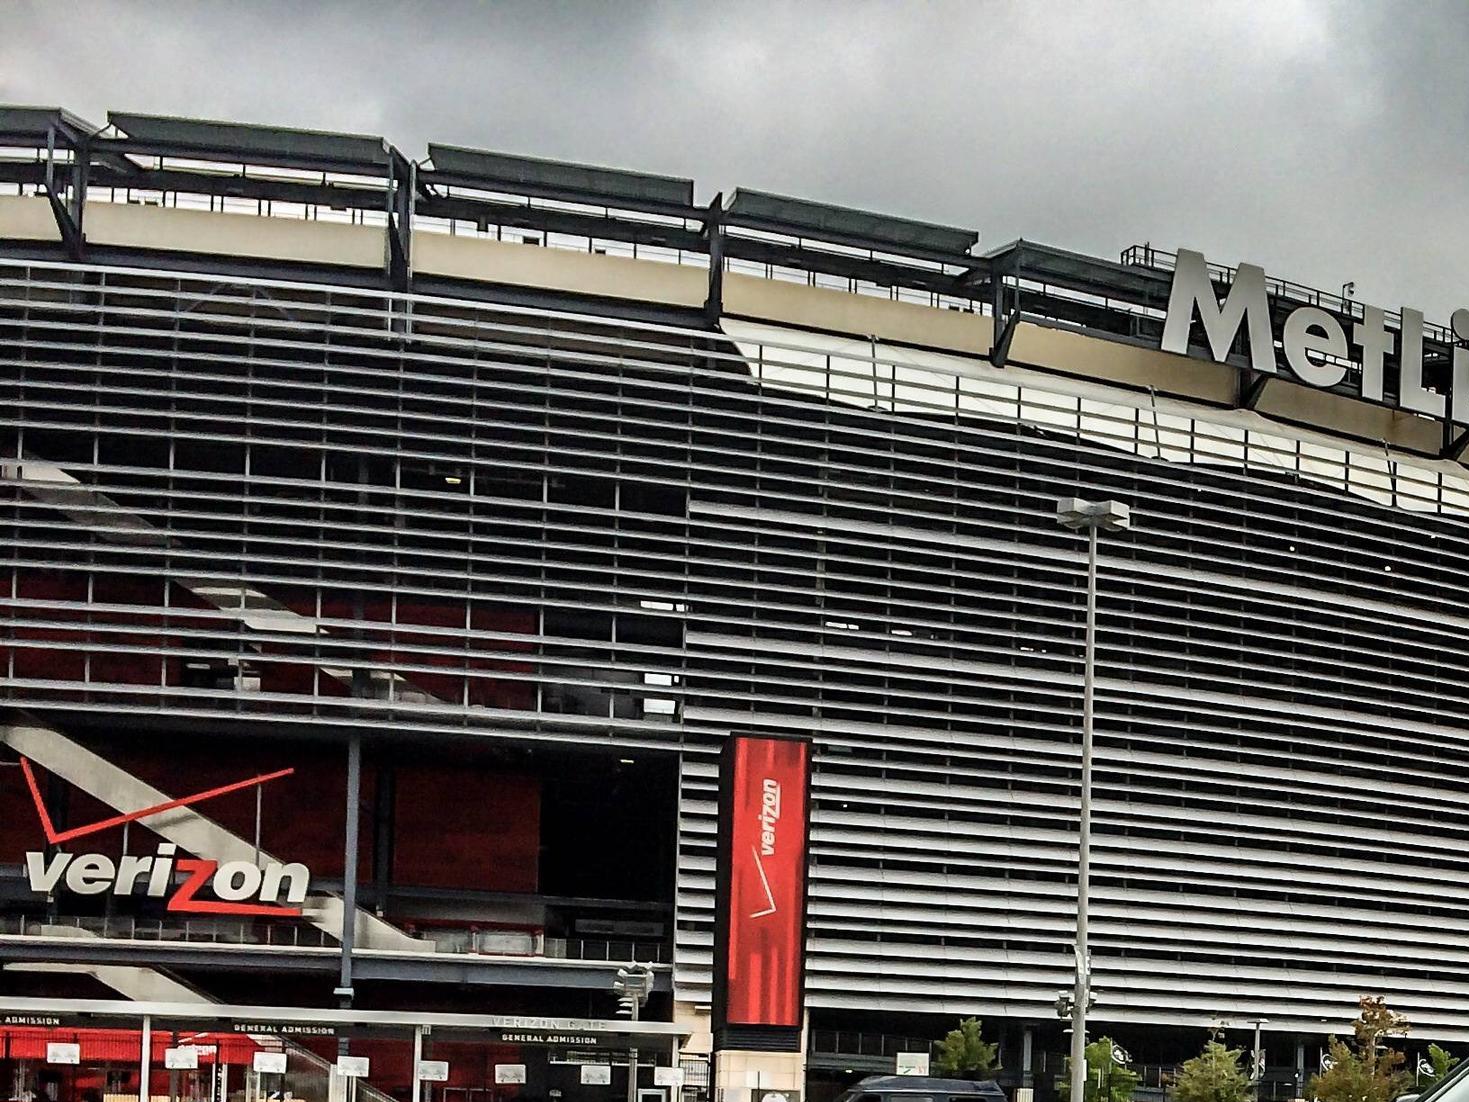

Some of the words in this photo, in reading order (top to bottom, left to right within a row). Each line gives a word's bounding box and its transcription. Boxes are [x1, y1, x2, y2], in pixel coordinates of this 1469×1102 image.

[758, 778, 782, 856] verizon
[25, 842, 311, 916] verizon
[4, 1015, 61, 1026] ADMISSION
[233, 1023, 279, 1034] GENERAL
[281, 1025, 335, 1036] ADMISSION
[502, 1033, 545, 1043] GENERAL
[545, 1034, 597, 1045] ADMISSION
